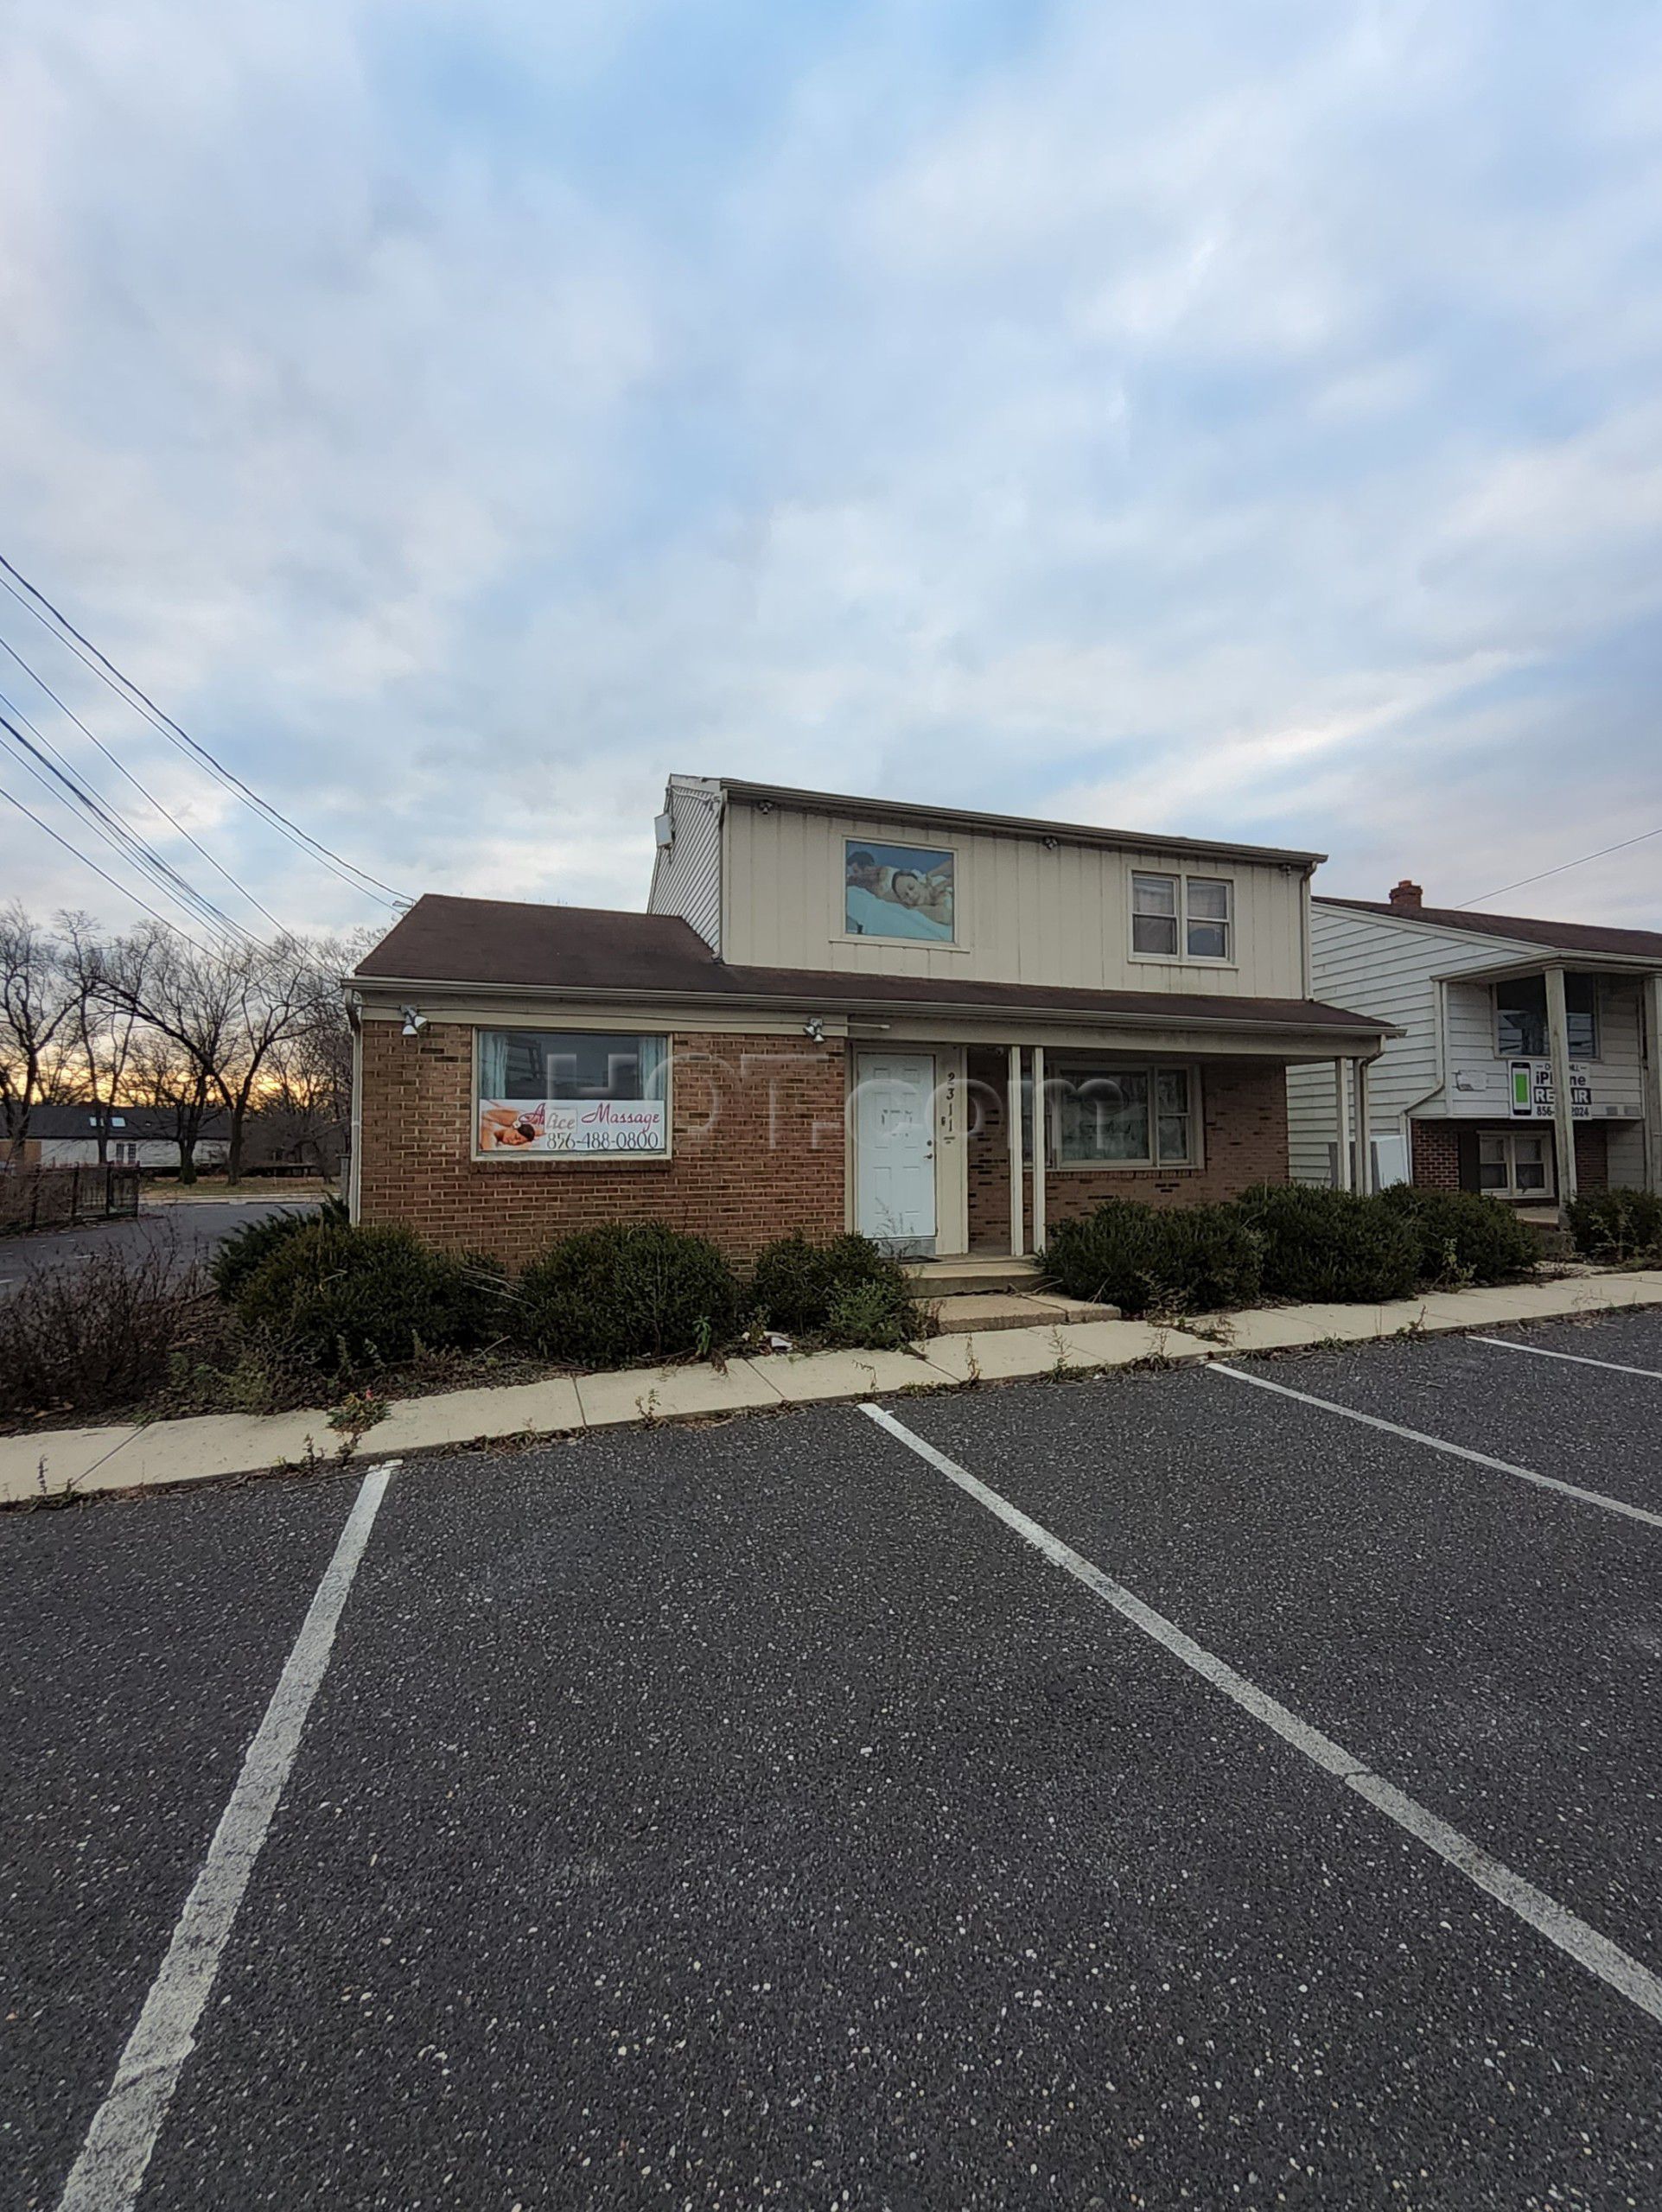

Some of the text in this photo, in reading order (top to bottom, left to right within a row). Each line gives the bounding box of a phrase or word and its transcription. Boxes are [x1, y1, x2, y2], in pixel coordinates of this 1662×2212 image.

[1536, 1071, 1586, 1086] iPne
[946, 1072, 955, 1132] 2311
[1536, 1089, 1589, 1103] REIR
[582, 1103, 659, 1133] Massage
[547, 1132, 659, 1149] 856-488-0800
